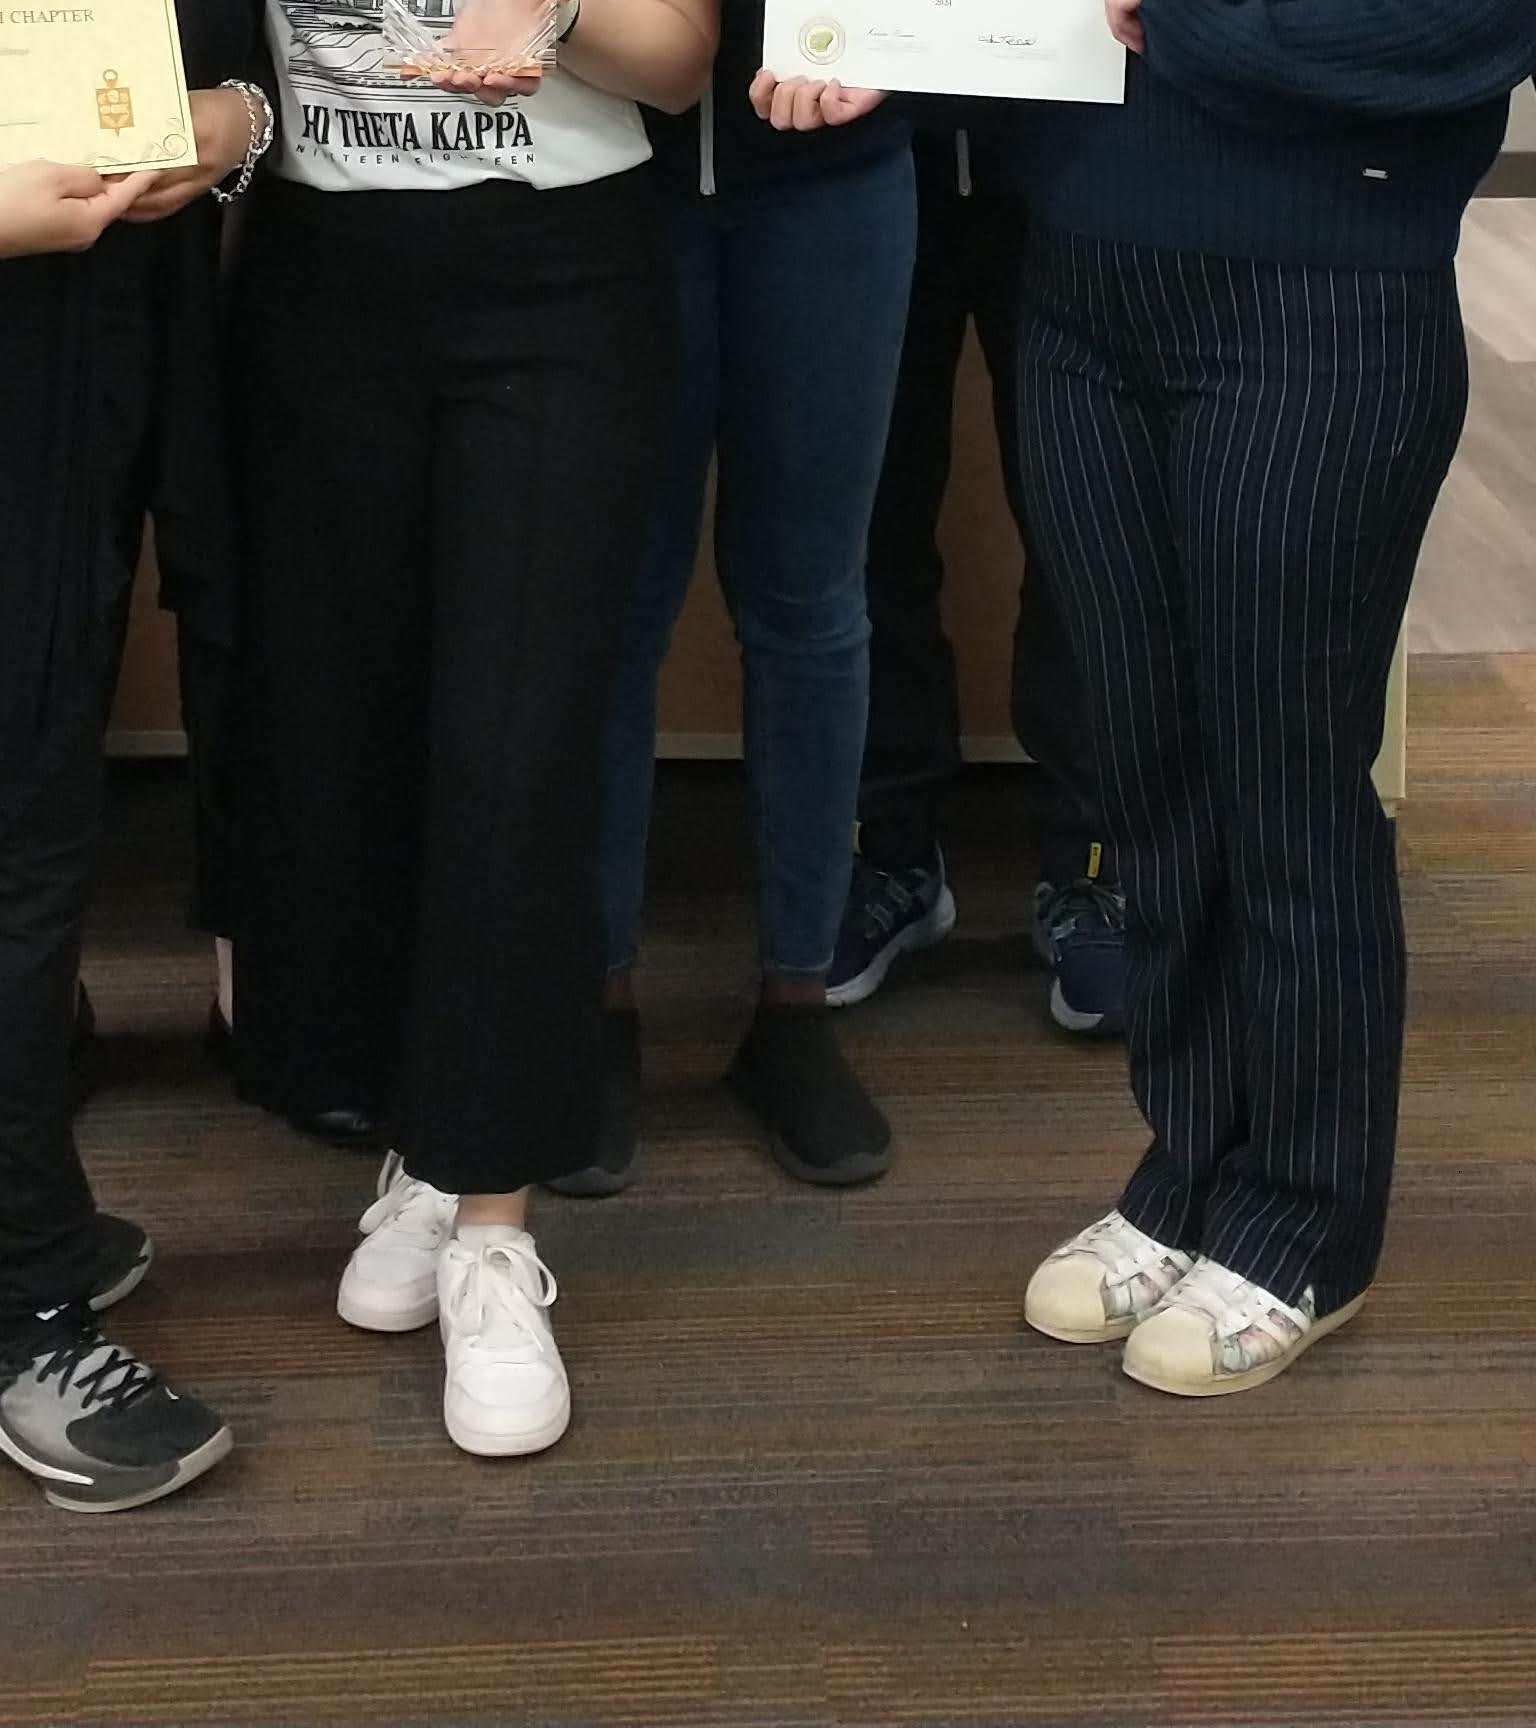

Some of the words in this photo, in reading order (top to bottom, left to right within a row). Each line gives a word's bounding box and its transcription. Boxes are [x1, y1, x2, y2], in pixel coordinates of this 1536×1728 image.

[9, 8, 96, 25] CHAPTER
[301, 104, 331, 146] HI
[335, 108, 423, 151] THETA
[429, 110, 535, 151] KAPPA
